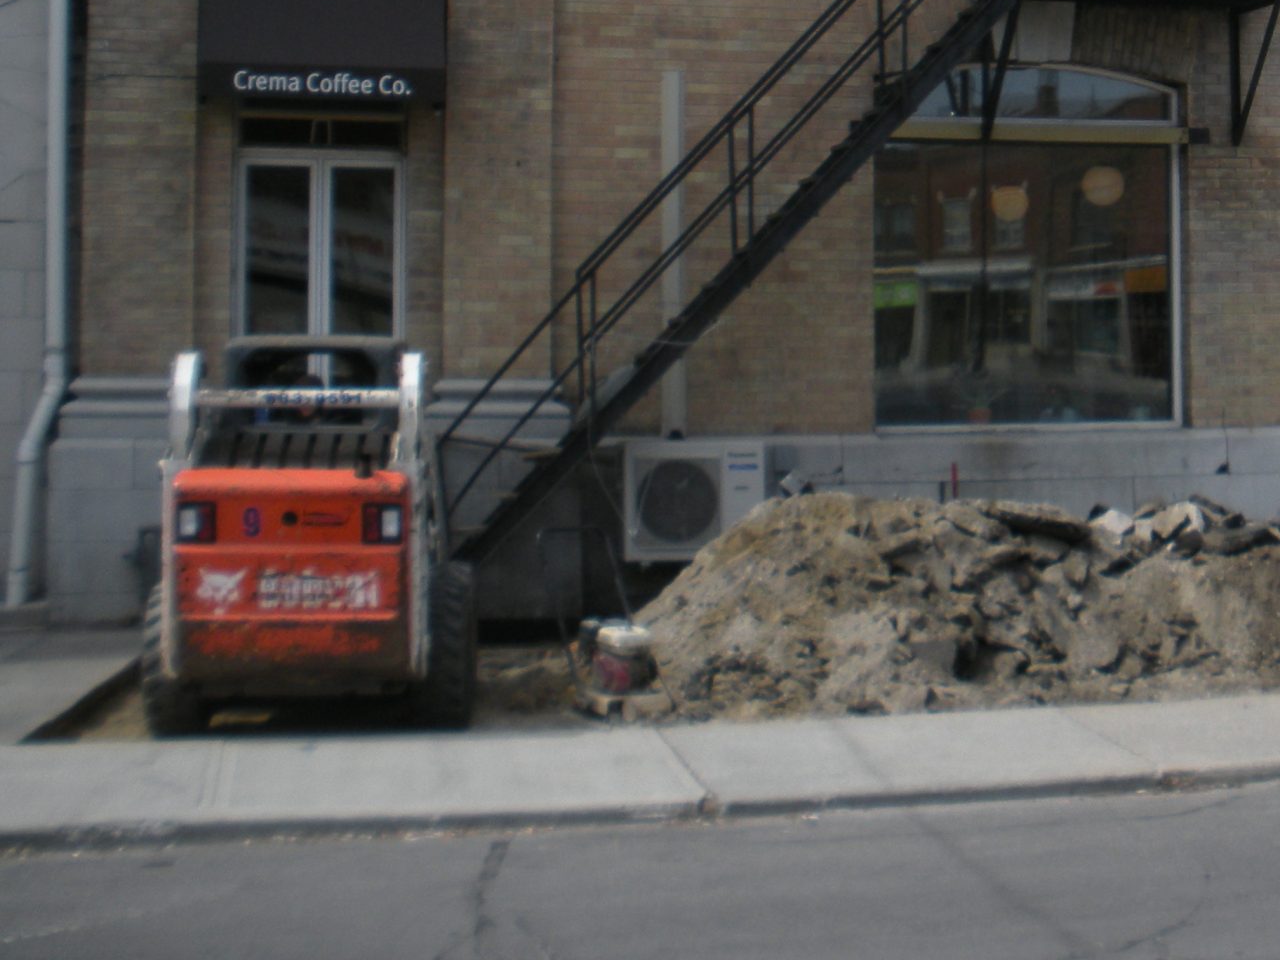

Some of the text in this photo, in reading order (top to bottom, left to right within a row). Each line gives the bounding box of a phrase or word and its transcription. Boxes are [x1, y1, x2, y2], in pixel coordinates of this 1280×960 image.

[234, 70, 411, 95] Crema Coffee Co.
[243, 507, 261, 538] 9
